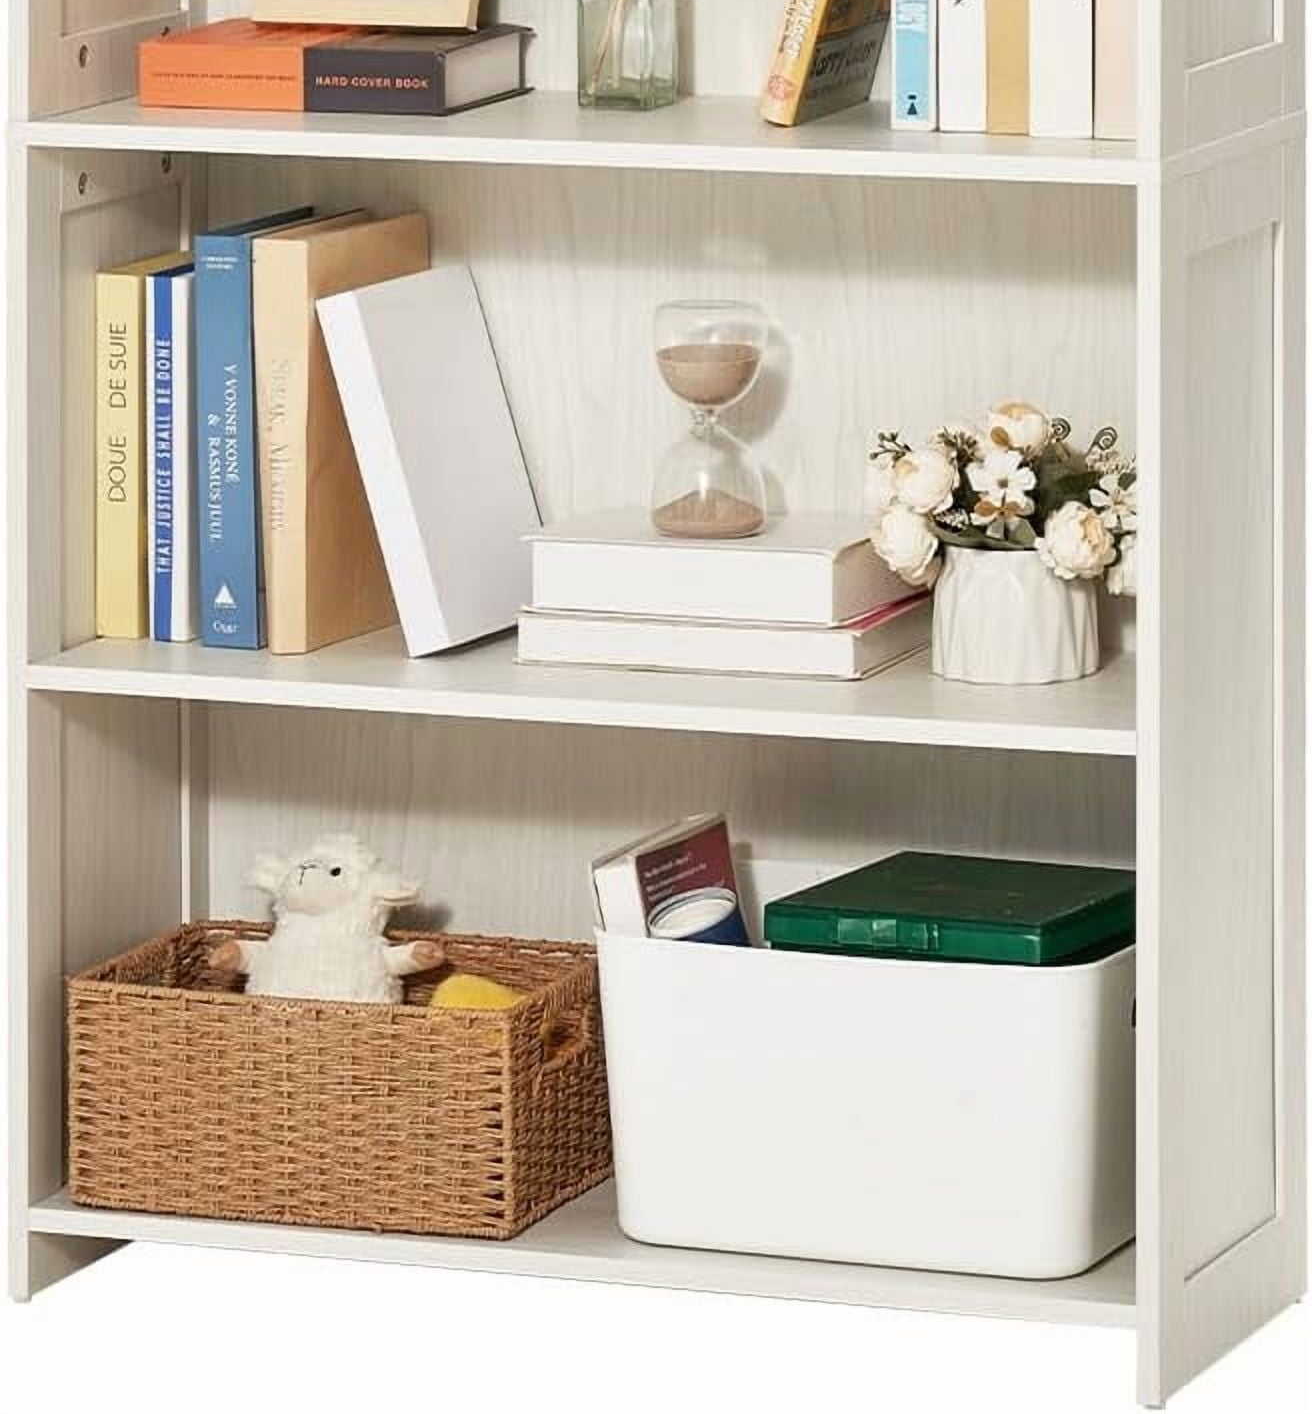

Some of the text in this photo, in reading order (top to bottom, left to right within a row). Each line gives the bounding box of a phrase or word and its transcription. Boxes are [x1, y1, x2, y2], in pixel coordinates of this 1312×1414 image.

[315, 75, 430, 90] HARD COVER BOOK
[108, 323, 127, 372] SUIE
[108, 378, 127, 409] DE
[207, 413, 221, 427] &
[156, 338, 172, 574] THAT JUSTICE SHALL BE DONE
[208, 437, 222, 502] RASMUS
